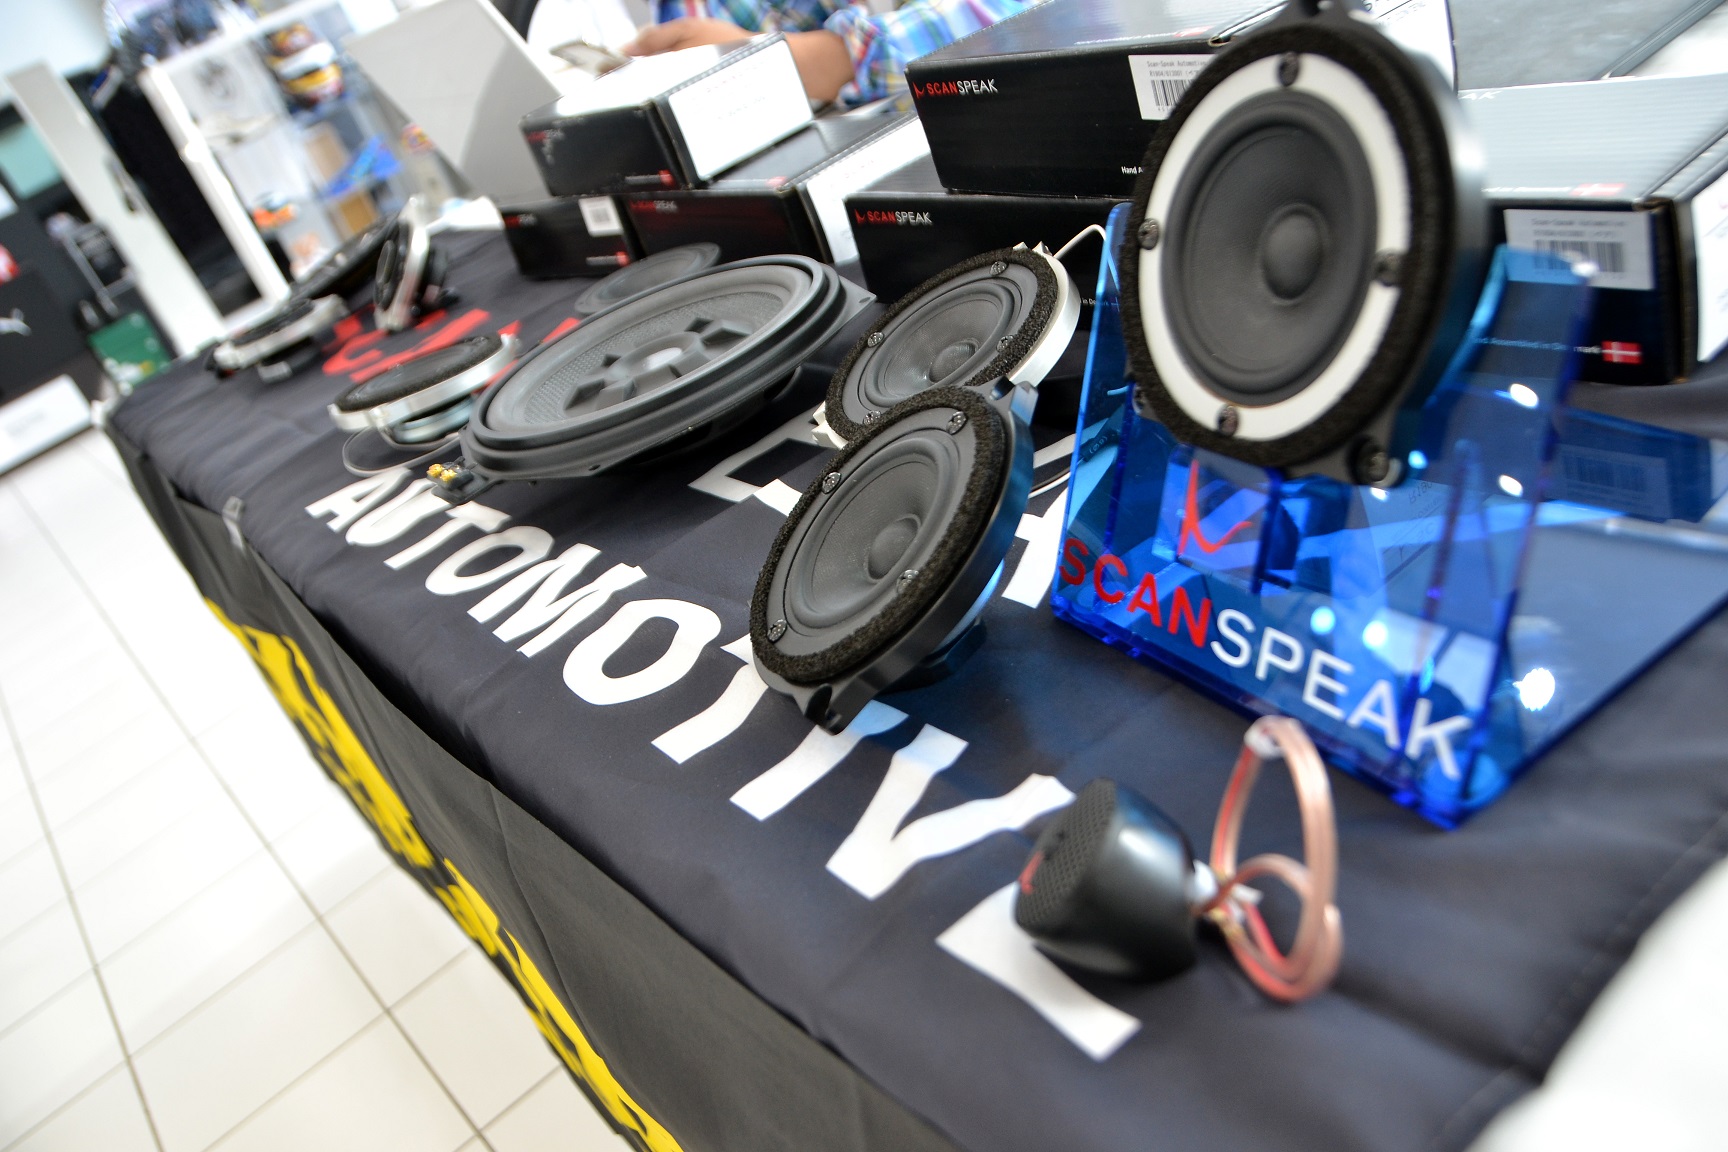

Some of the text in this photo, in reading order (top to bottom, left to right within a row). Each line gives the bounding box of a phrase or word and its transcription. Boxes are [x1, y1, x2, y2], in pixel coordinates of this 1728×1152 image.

[926, 79, 998, 95] SCANSPEAK
[866, 210, 932, 225] SCANSPEAK
[1058, 538, 1473, 780] SCANSPEAK
